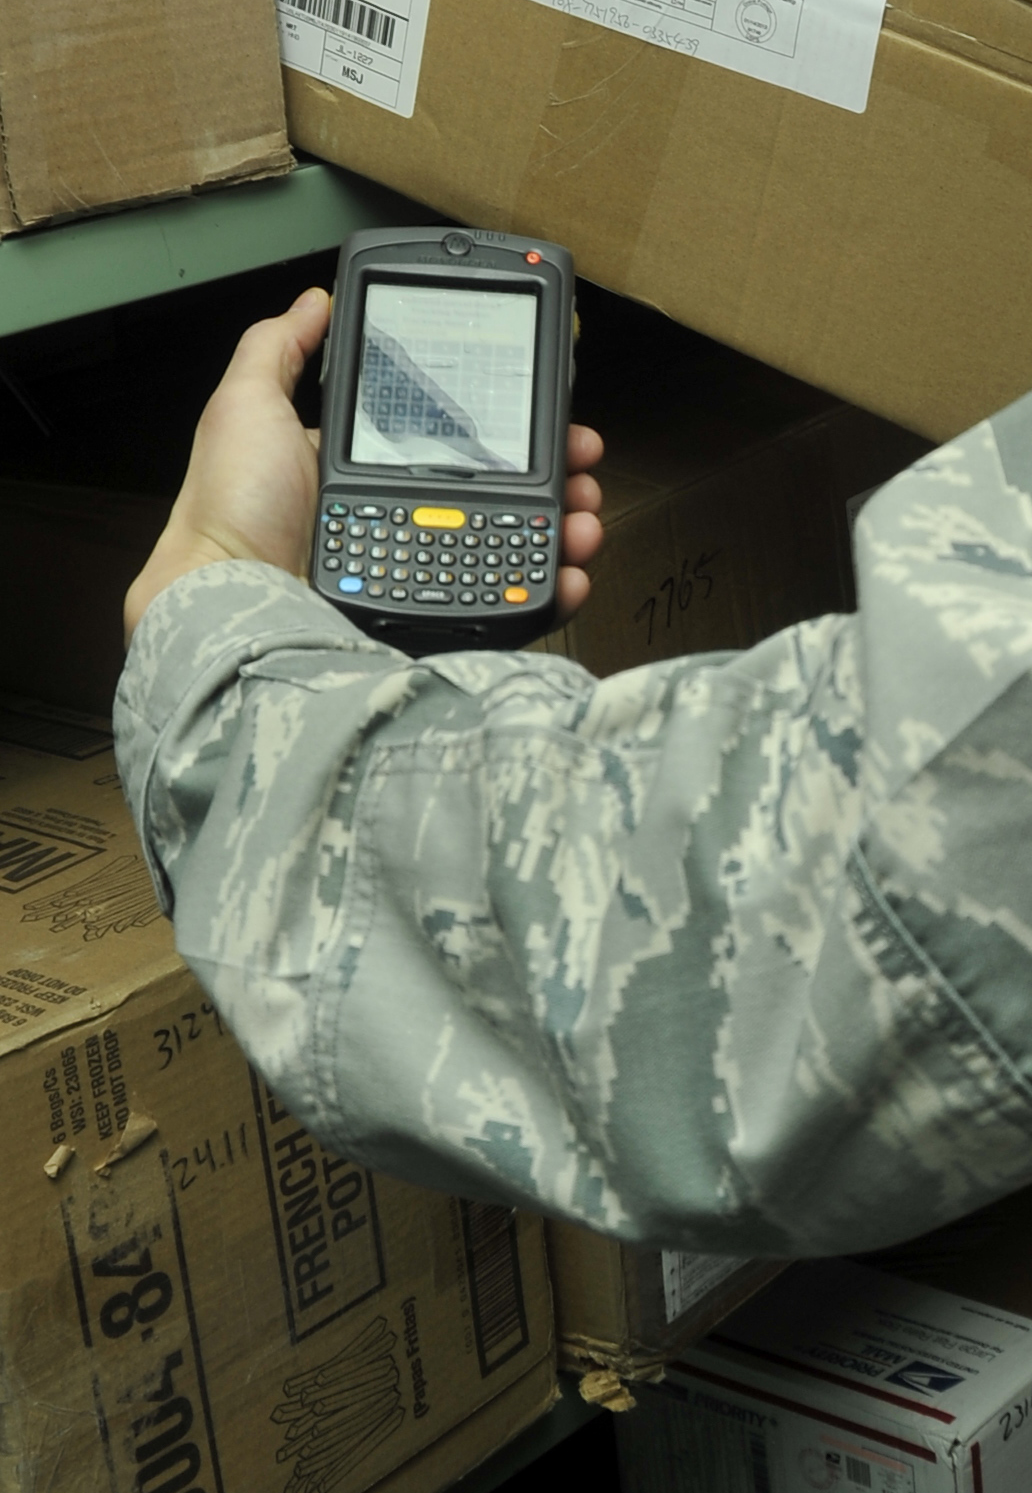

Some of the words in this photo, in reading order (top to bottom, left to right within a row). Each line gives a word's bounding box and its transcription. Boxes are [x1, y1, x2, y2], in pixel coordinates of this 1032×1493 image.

[342, 65, 364, 85] MSJ
[60, 1046, 82, 1092] 23065
[86, 1035, 109, 1095] FROZEN
[103, 1029, 123, 1074] DROP
[43, 1067, 67, 1126] Bags/Cs
[112, 1075, 128, 1105] NOT
[68, 1094, 88, 1136] WSI:
[93, 1097, 113, 1142] KEEP
[172, 1121, 253, 1193] 24.11
[273, 1132, 336, 1308] FRENCH
[404, 1295, 424, 1357] Fritas)
[803, 1345, 885, 1380] PRIORITY
[859, 1342, 907, 1367] MAIL
[410, 1358, 431, 1420] (Papas
